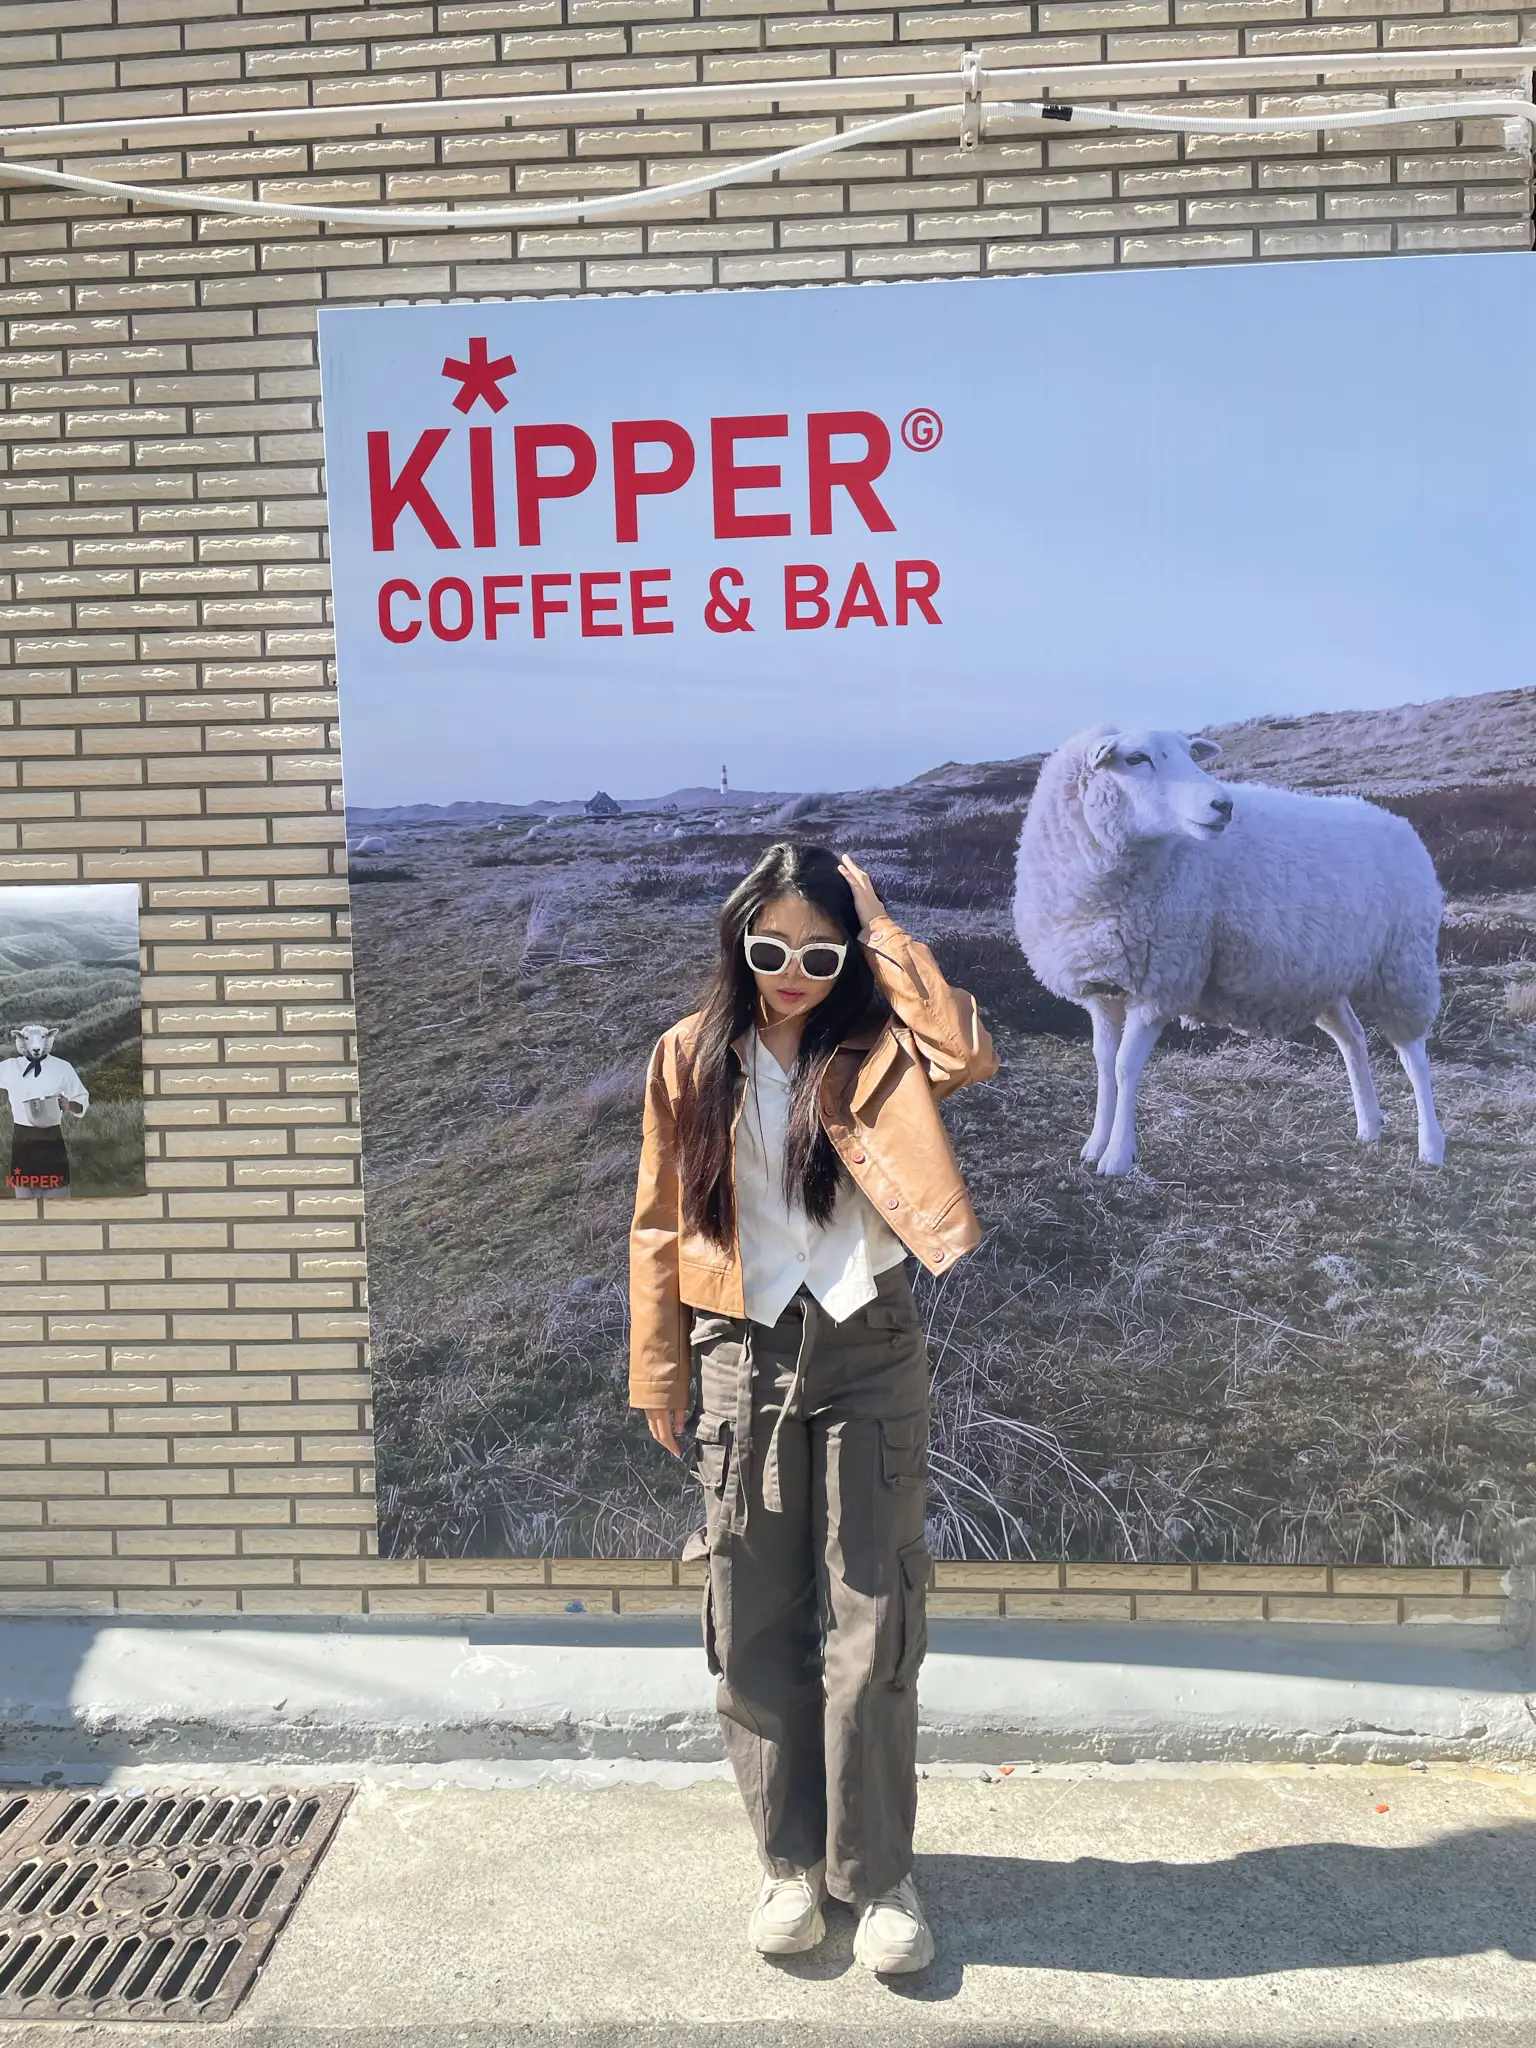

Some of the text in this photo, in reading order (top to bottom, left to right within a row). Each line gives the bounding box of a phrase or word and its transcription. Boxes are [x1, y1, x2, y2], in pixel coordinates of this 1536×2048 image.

[367, 410, 897, 552] KIPPER
[378, 559, 943, 644] COFFEE & BAR
[5, 1174, 60, 1188] KIPPER
